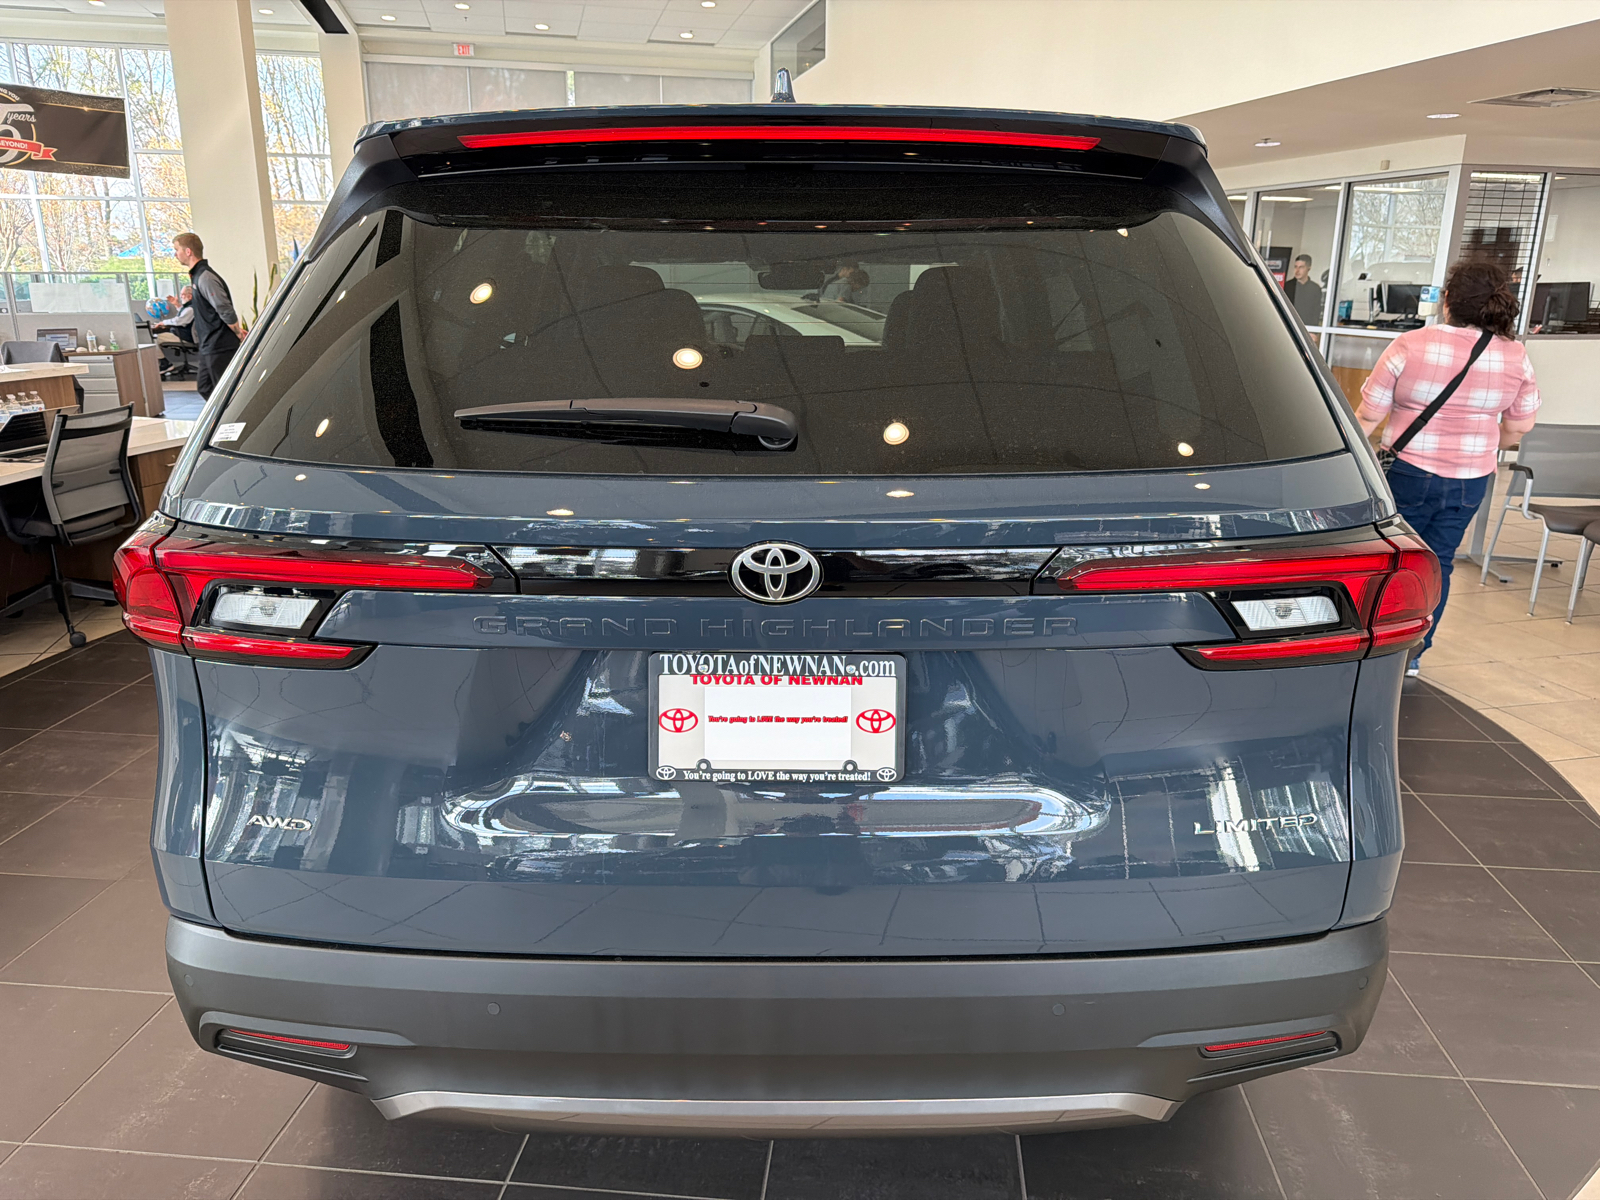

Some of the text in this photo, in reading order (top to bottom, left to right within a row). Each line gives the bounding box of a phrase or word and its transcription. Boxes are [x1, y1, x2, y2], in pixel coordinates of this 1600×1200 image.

[457, 44, 470, 56] EXIT
[8, 90, 20, 101] YOU
[7, 112, 37, 124] years
[0, 139, 28, 149] EYOND!
[472, 615, 1078, 638] GRAND HIGHLANDER
[690, 674, 863, 686] TOYOTA OF NEWNAN
[683, 770, 871, 783] You're going to LOVE the way you're treated!
[246, 814, 312, 831] AWD
[1193, 813, 1317, 835] LIMITED
